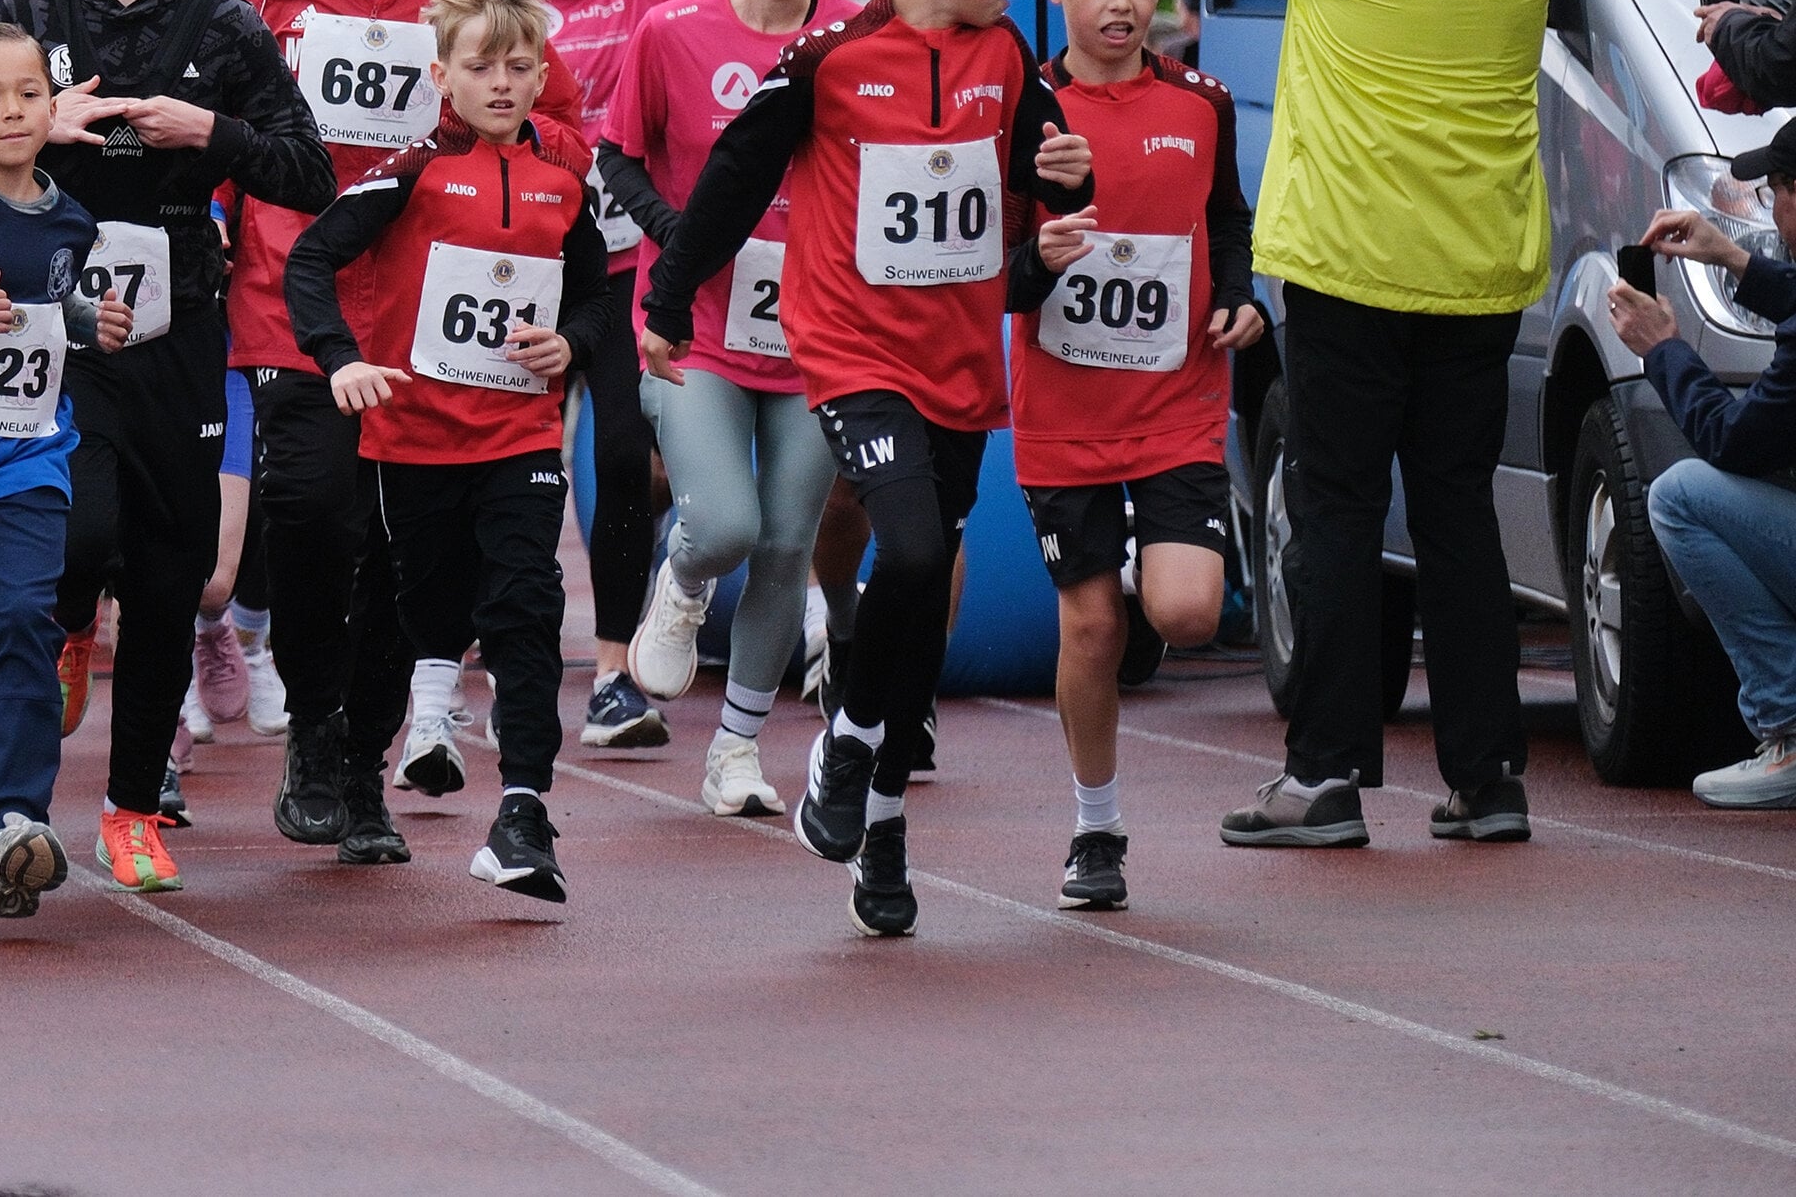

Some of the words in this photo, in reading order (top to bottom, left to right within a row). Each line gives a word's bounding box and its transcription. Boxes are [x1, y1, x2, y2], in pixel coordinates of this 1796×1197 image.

[677, 4, 698, 16] JAKO
[321, 57, 422, 112] 687
[857, 84, 895, 97] JAKO
[962, 89, 973, 104] FC
[318, 123, 413, 145] SCHWEINELAUF
[101, 146, 143, 157] Topward
[1151, 137, 1161, 151] FC
[444, 182, 477, 197] JAKO
[883, 187, 987, 244] 310
[885, 264, 985, 279] SCHWEINELAUF
[1063, 274, 1168, 331] 309
[442, 293, 537, 350] 631
[1061, 342, 1160, 365] SCHWEINELAUF
[436, 361, 530, 388] SCHWEINELAUF
[859, 435, 895, 469] LW
[530, 471, 560, 485] JAKO
